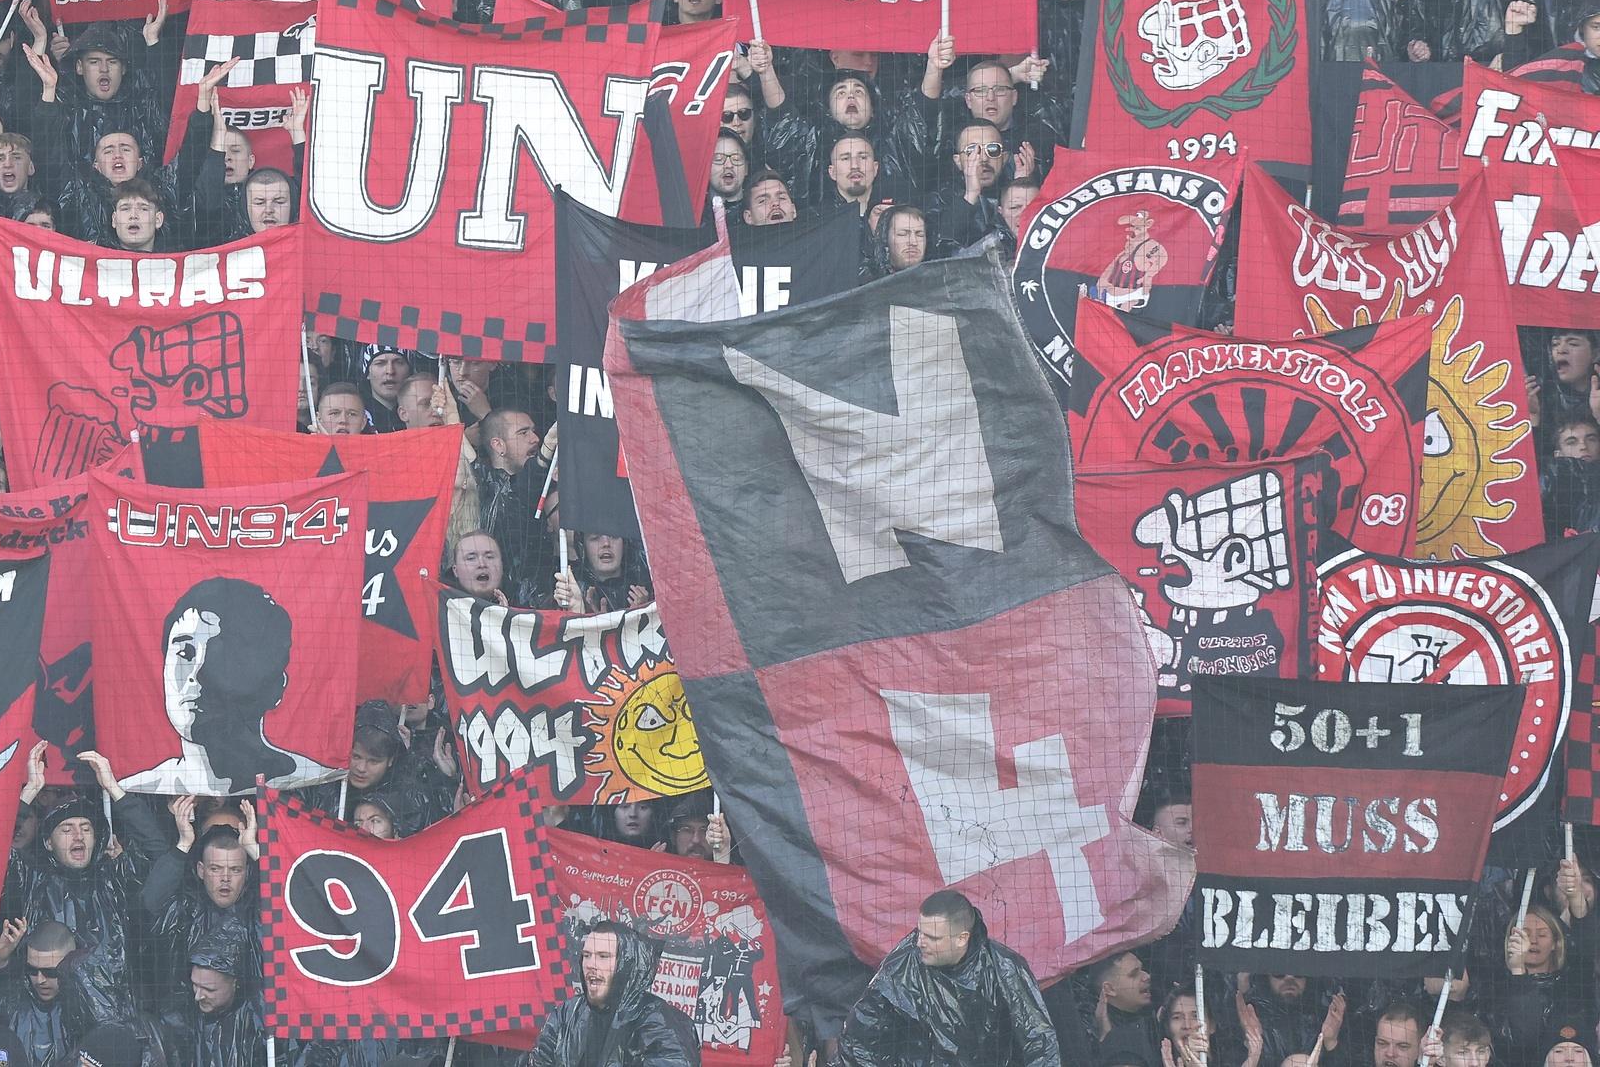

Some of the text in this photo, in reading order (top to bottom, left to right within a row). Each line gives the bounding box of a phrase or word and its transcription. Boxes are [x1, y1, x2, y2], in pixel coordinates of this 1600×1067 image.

[13, 245, 266, 308] ULTRAS
[1118, 343, 1389, 433] FRANKENSTOLZ
[115, 497, 342, 548] UN94
[1348, 559, 1398, 604] ZU
[1268, 700, 1425, 759] 50+1
[1253, 790, 1441, 855] MUSS
[286, 827, 541, 986] 94
[1200, 885, 1470, 954] BLEIBEN
